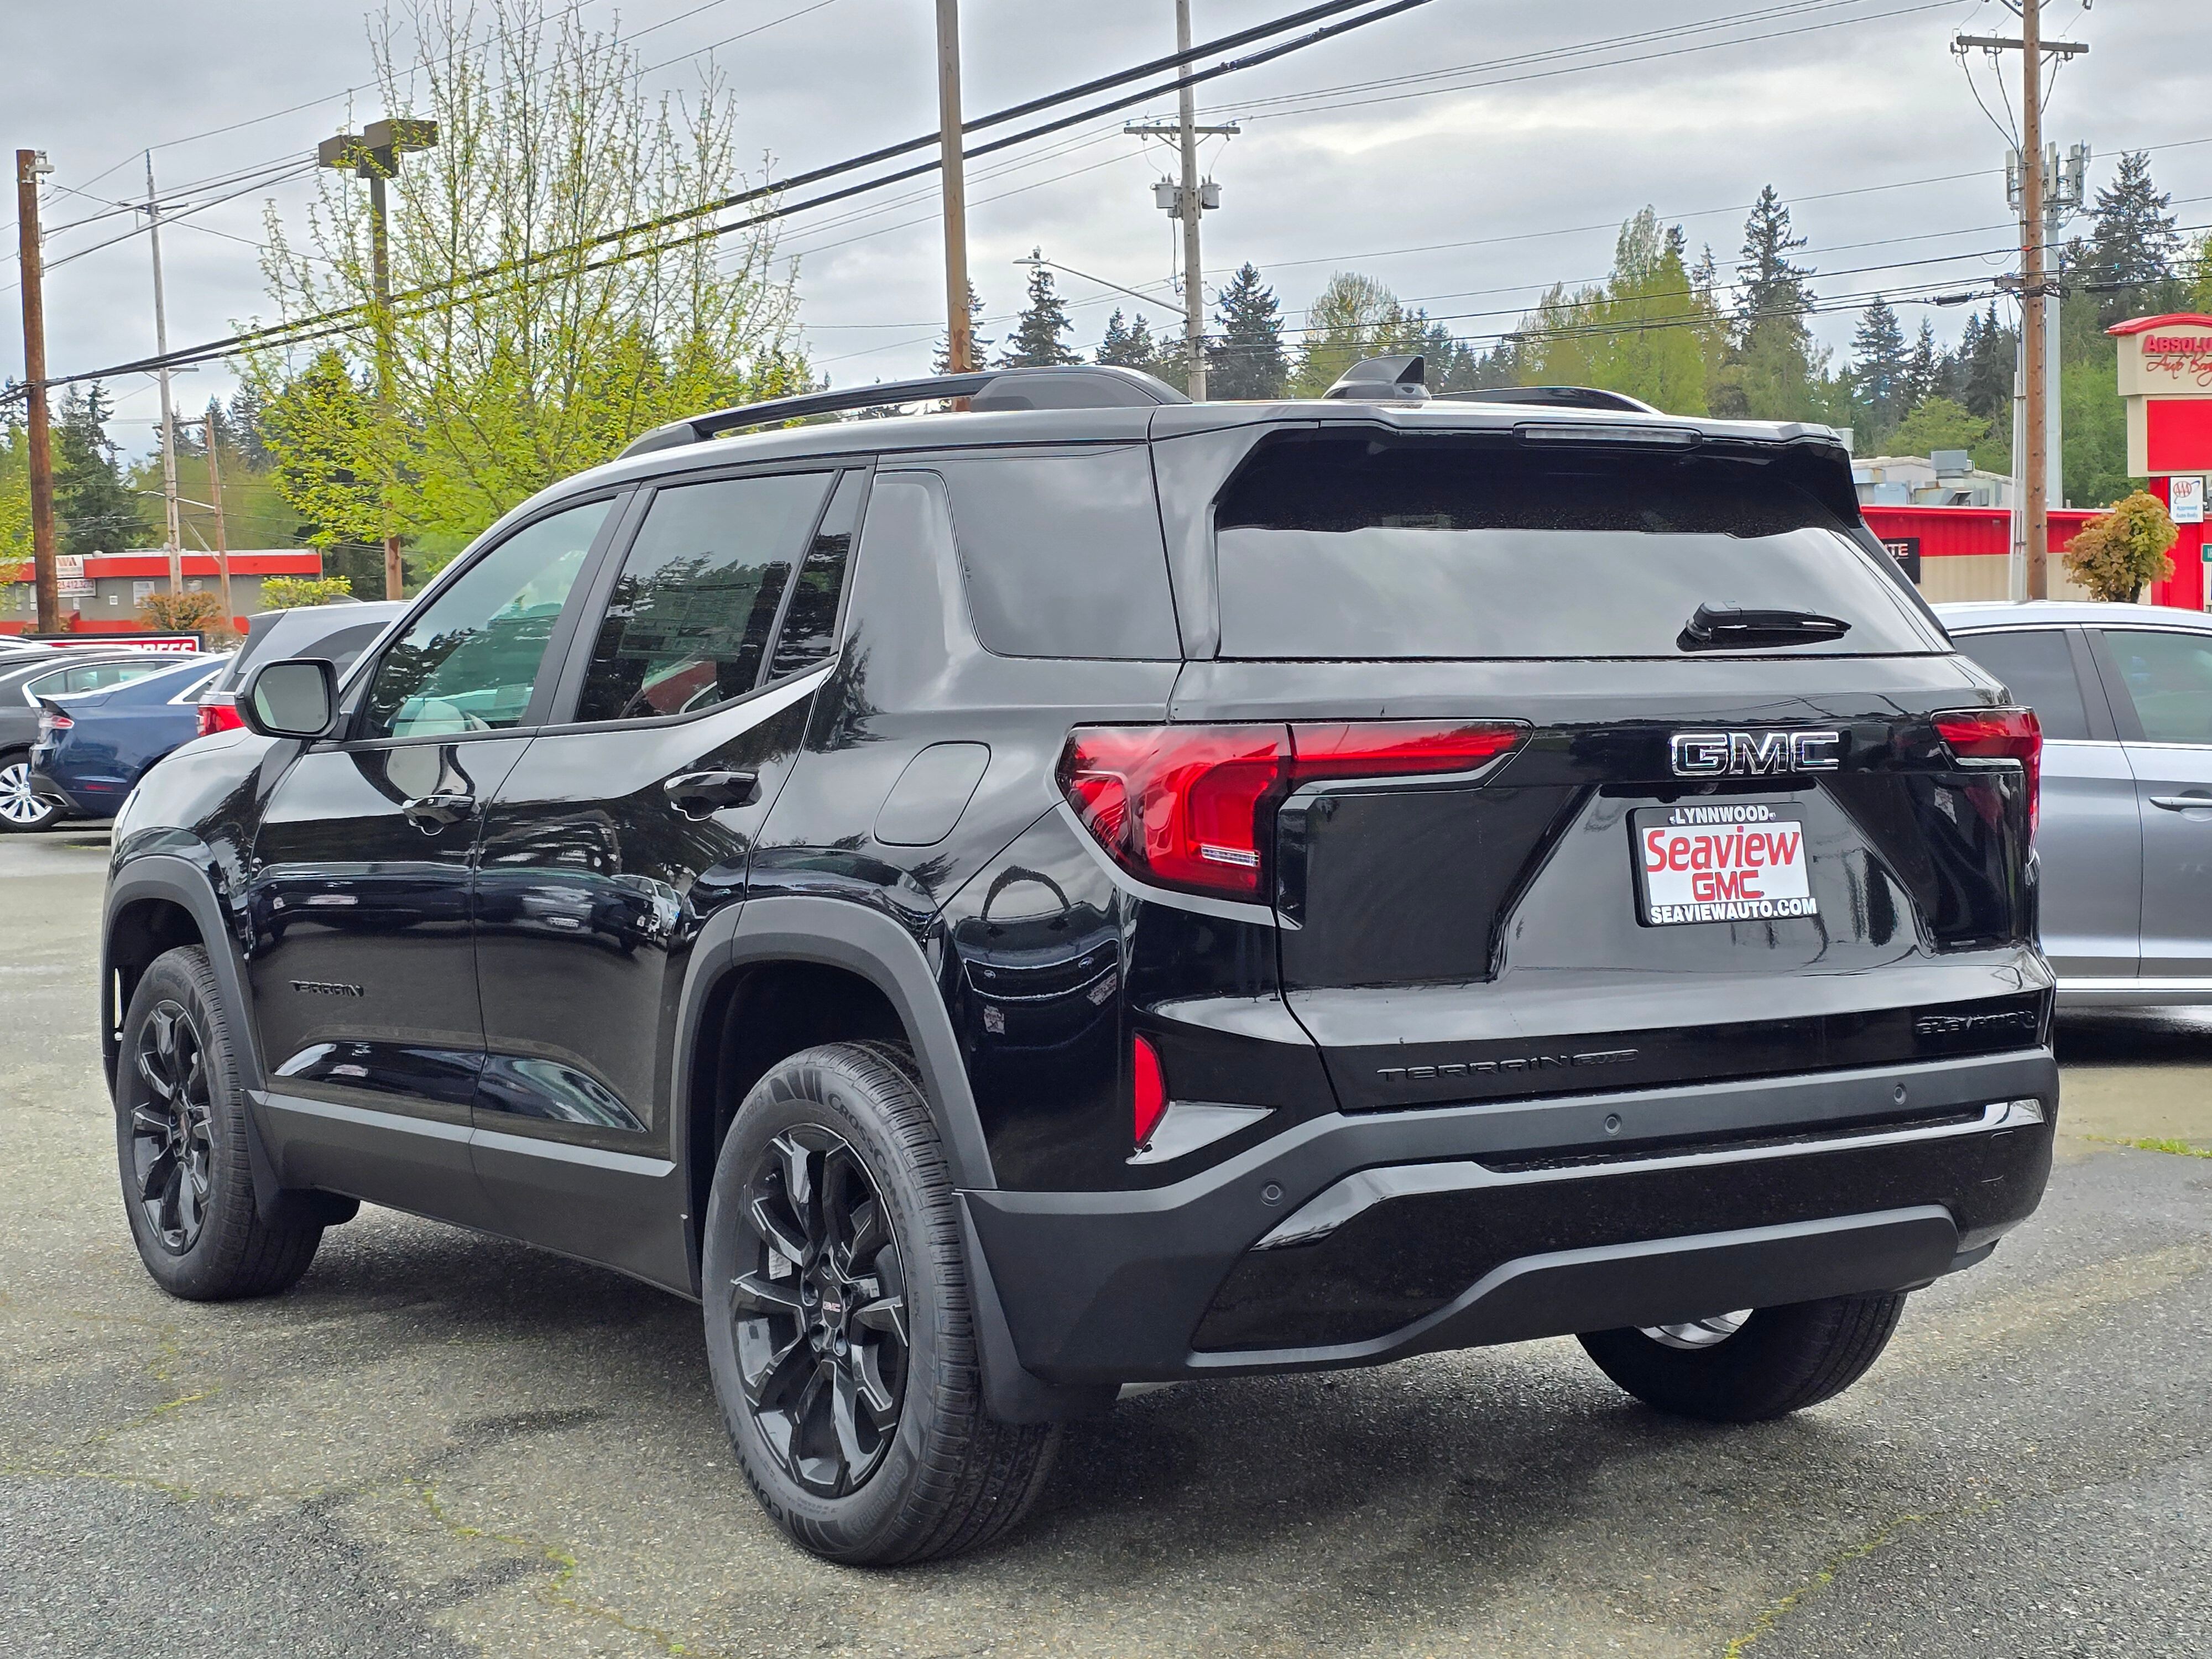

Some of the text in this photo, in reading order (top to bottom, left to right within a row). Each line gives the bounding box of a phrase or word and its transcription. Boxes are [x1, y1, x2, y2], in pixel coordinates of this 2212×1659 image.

[2174, 481, 2192, 497] AAA
[1670, 731, 1839, 776] GMC
[1674, 806, 1769, 824] LYNNWOOD
[1646, 826, 1800, 872] Seaview
[1692, 870, 1765, 902] GMC
[1651, 898, 1818, 924] SEAVIEWAUTO.COM
[288, 976, 364, 997] TERRAIN
[1377, 1055, 1567, 1082] TERRAIN
